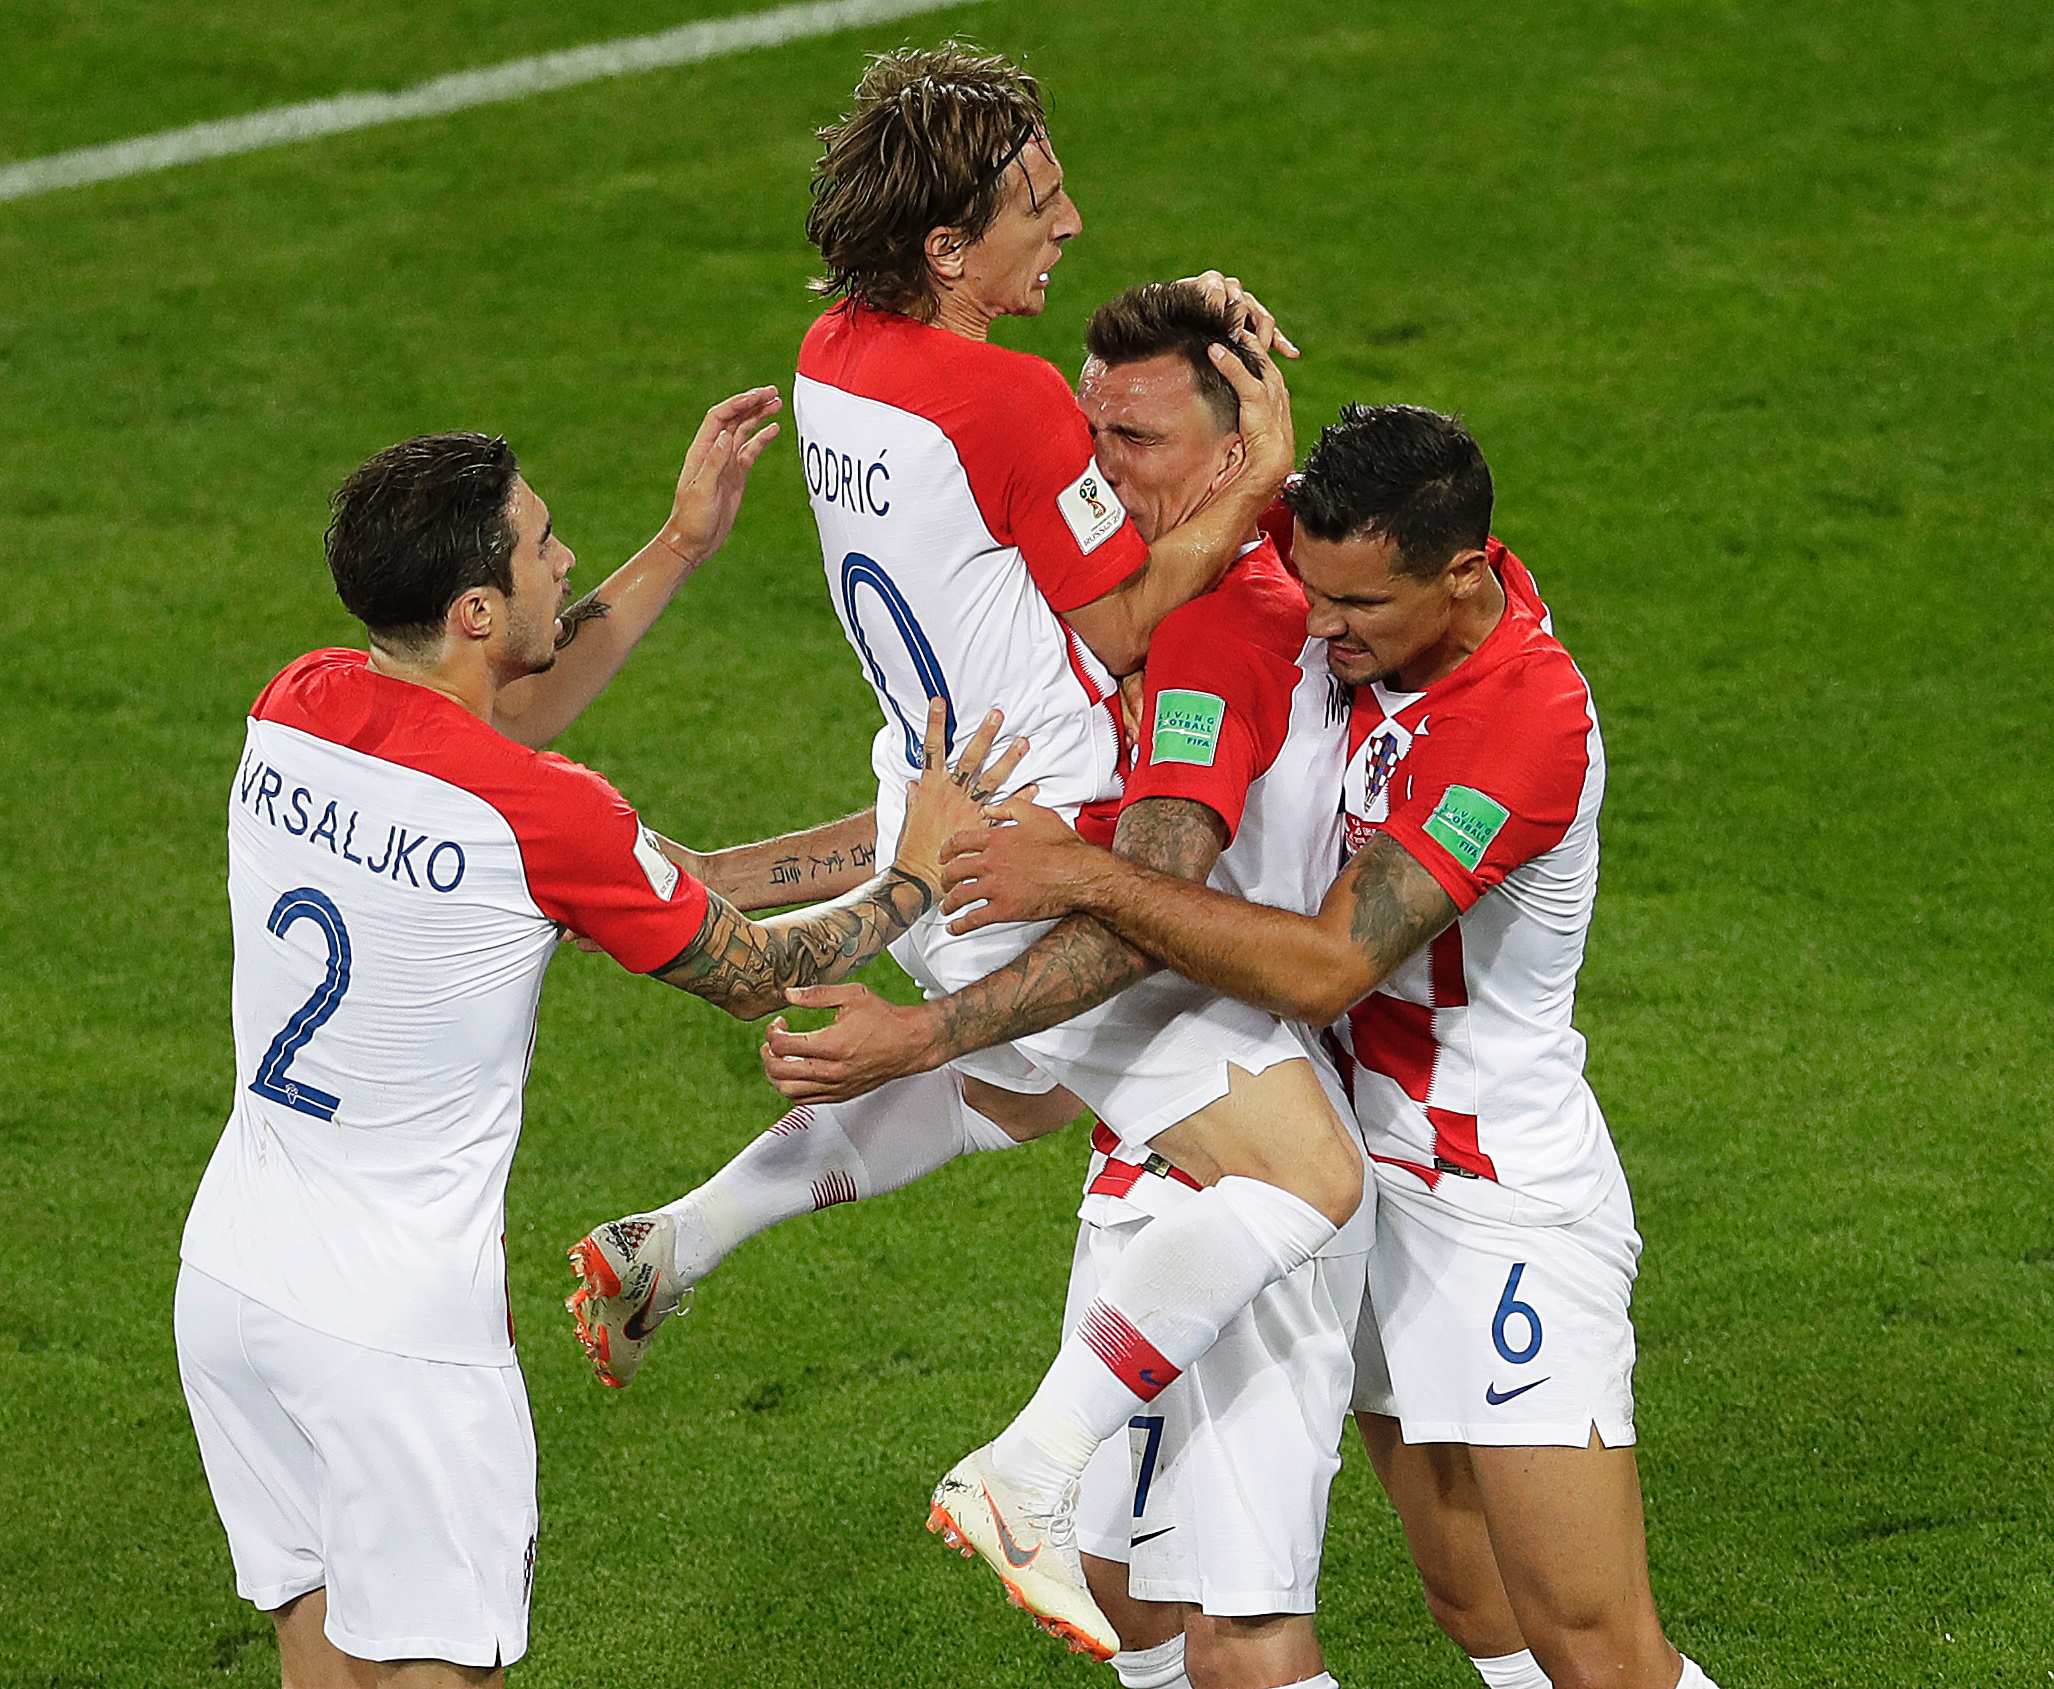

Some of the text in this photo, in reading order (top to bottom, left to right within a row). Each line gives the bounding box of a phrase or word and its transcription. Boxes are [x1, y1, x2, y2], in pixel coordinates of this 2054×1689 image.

[800, 435, 889, 517] ODRIĆ
[1158, 711, 1214, 725] LIVING
[1187, 737, 1210, 747] FIFA
[241, 749, 465, 893] VRSALJKO
[1459, 841, 1478, 858] FIFA
[248, 887, 351, 1122] 2
[1492, 1263, 1543, 1364] 6
[1128, 1415, 1165, 1518] 7
